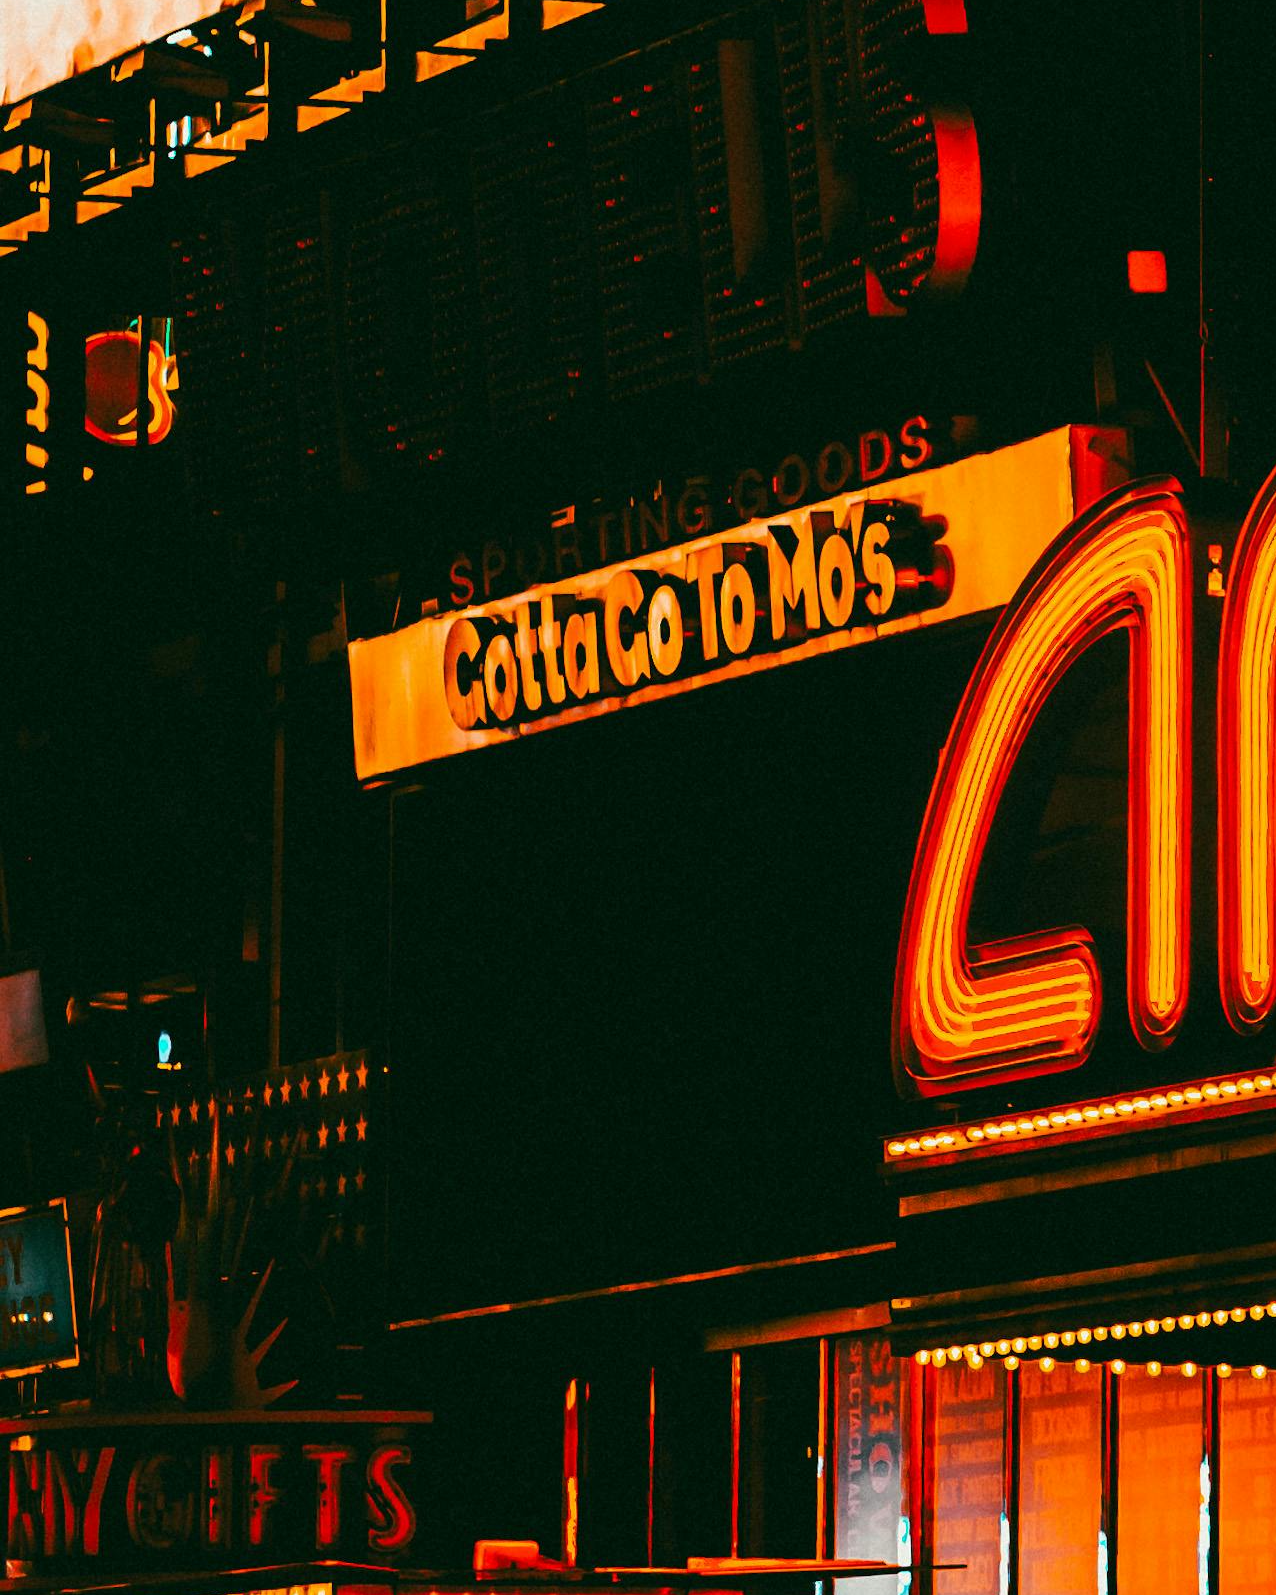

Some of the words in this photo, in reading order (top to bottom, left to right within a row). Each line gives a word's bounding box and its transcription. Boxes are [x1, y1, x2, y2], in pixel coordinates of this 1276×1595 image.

[734, 414, 932, 516] GOODS
[446, 596, 602, 730] Gotta
[603, 569, 685, 688] Go
[688, 543, 757, 662] To
[127, 1443, 417, 1552] GIFTS
